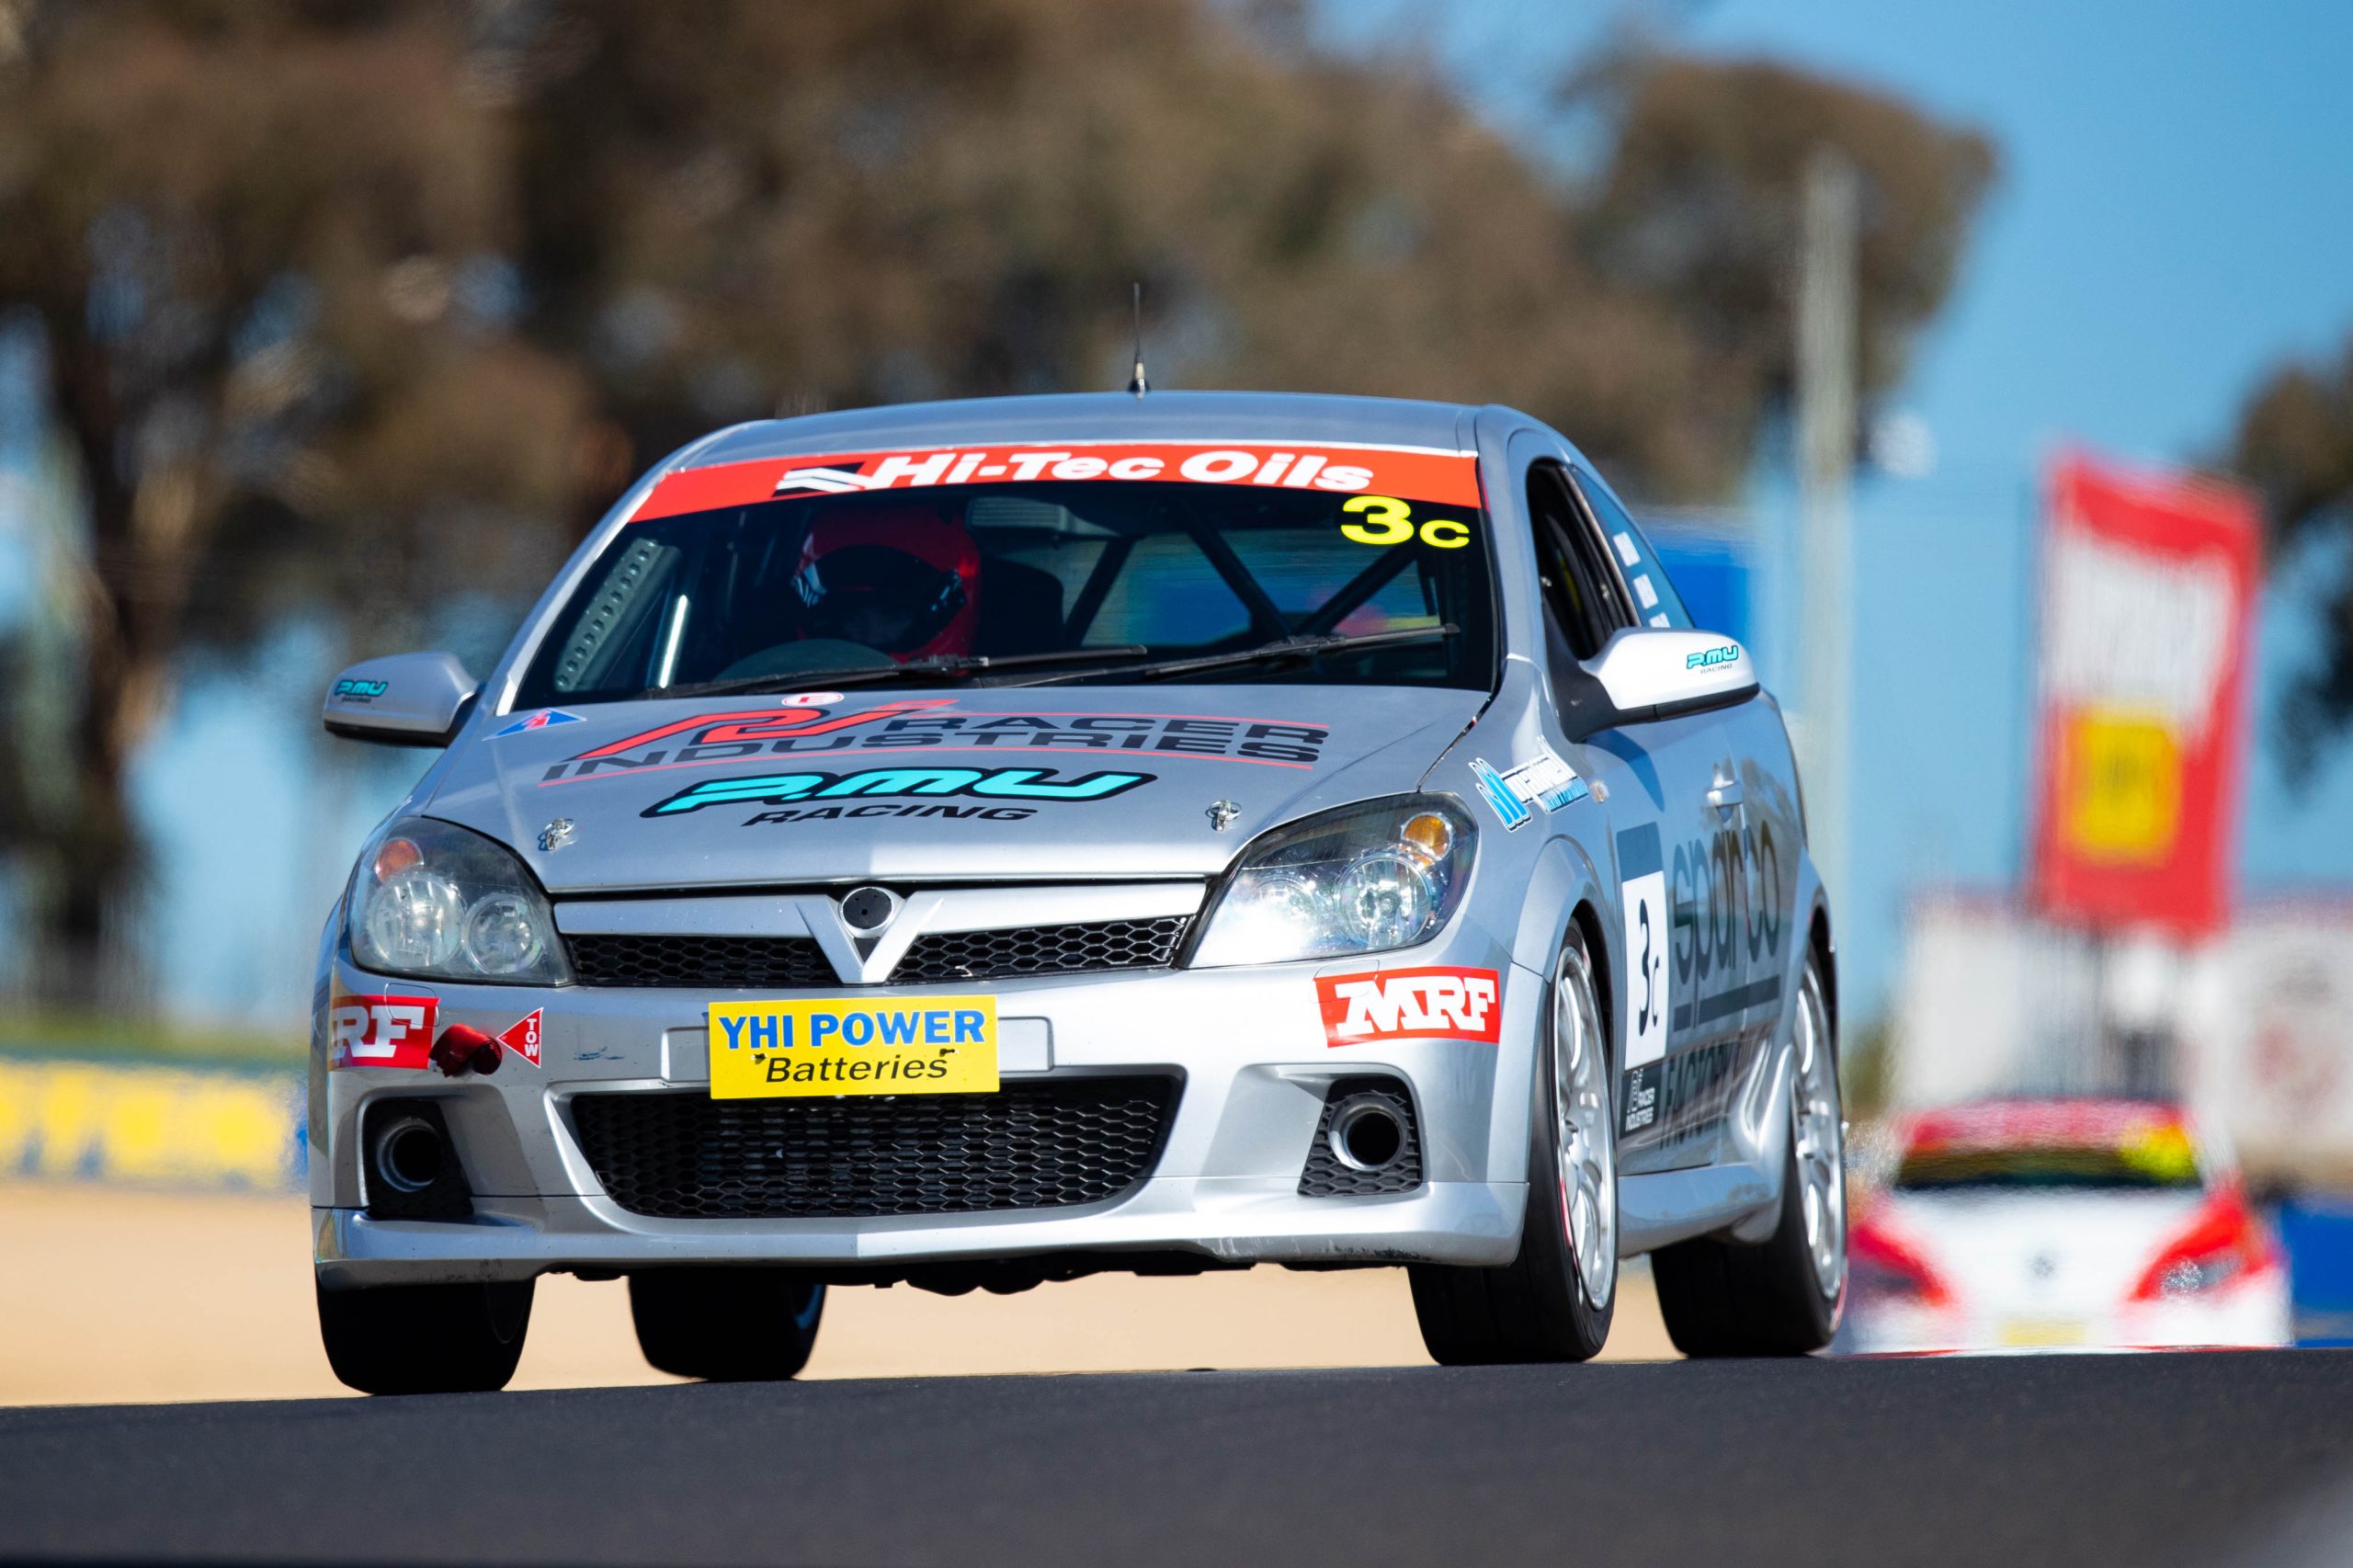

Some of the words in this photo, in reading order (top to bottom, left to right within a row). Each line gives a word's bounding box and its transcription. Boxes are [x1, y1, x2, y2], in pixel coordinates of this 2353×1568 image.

[869, 452, 1165, 489] Hi-Tec
[1180, 450, 1373, 491] Oils
[884, 717, 1329, 744] RACER
[542, 732, 1320, 780] INDUSTRIES
[740, 804, 1038, 827] RACING
[1673, 820, 1780, 1028] sparco
[1335, 976, 1496, 1037] MRF
[332, 1006, 425, 1058] RF
[524, 1018, 539, 1057] TOW
[717, 1014, 794, 1050] YHI
[810, 1009, 985, 1048] POWER
[766, 1054, 949, 1084] Batteries
